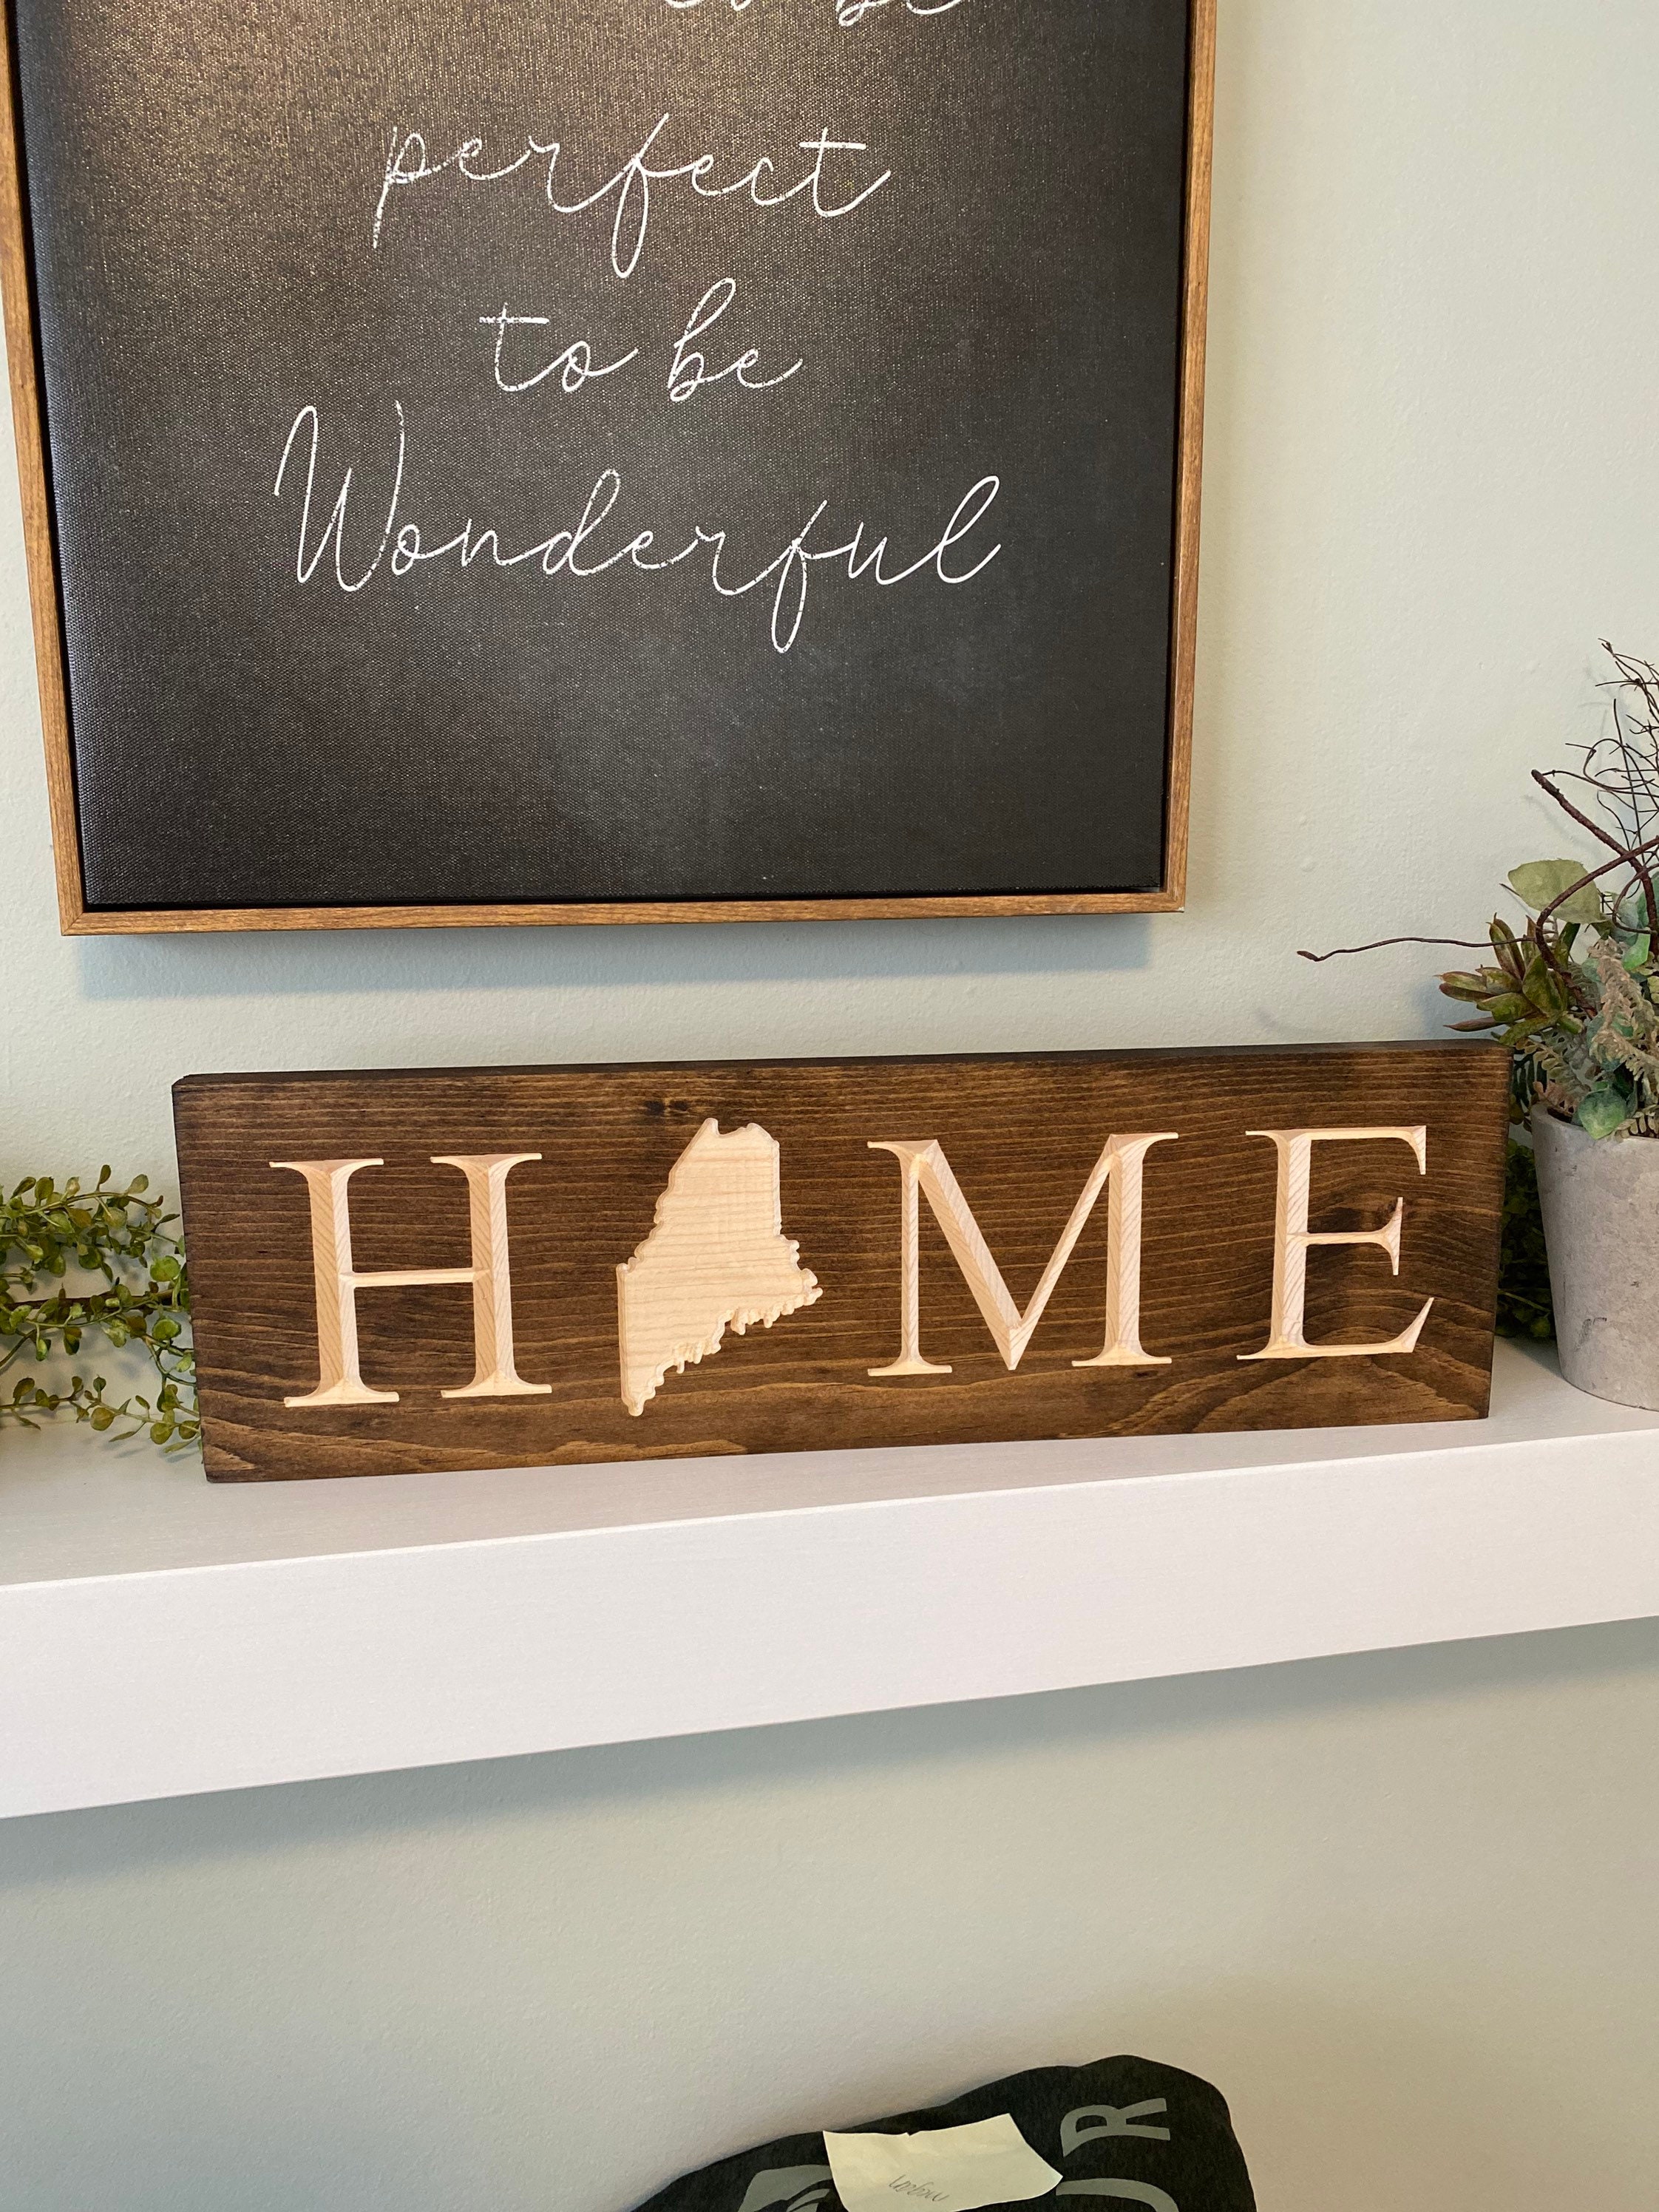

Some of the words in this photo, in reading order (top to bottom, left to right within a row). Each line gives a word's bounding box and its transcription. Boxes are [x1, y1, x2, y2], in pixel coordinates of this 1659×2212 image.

[373, 113, 891, 277] perfect
[479, 302, 639, 393] to
[669, 278, 803, 402] be
[274, 400, 1000, 653] Wonderful
